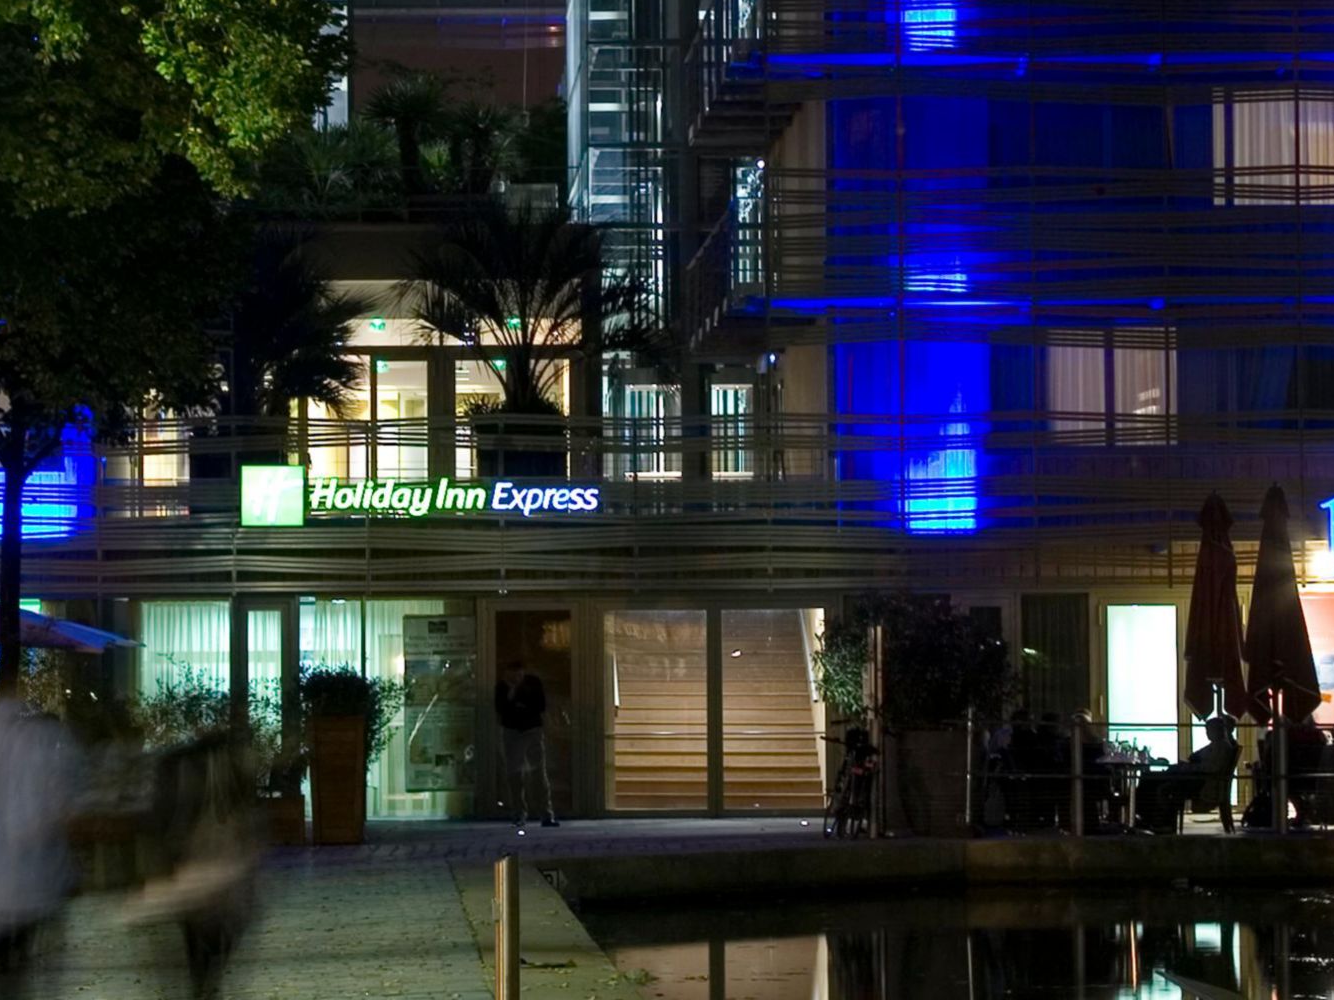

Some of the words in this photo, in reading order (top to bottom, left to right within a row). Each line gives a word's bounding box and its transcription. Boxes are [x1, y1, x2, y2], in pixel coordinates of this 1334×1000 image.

[309, 478, 433, 516] Holiday
[435, 477, 487, 509] Inn
[491, 481, 599, 516] Express
